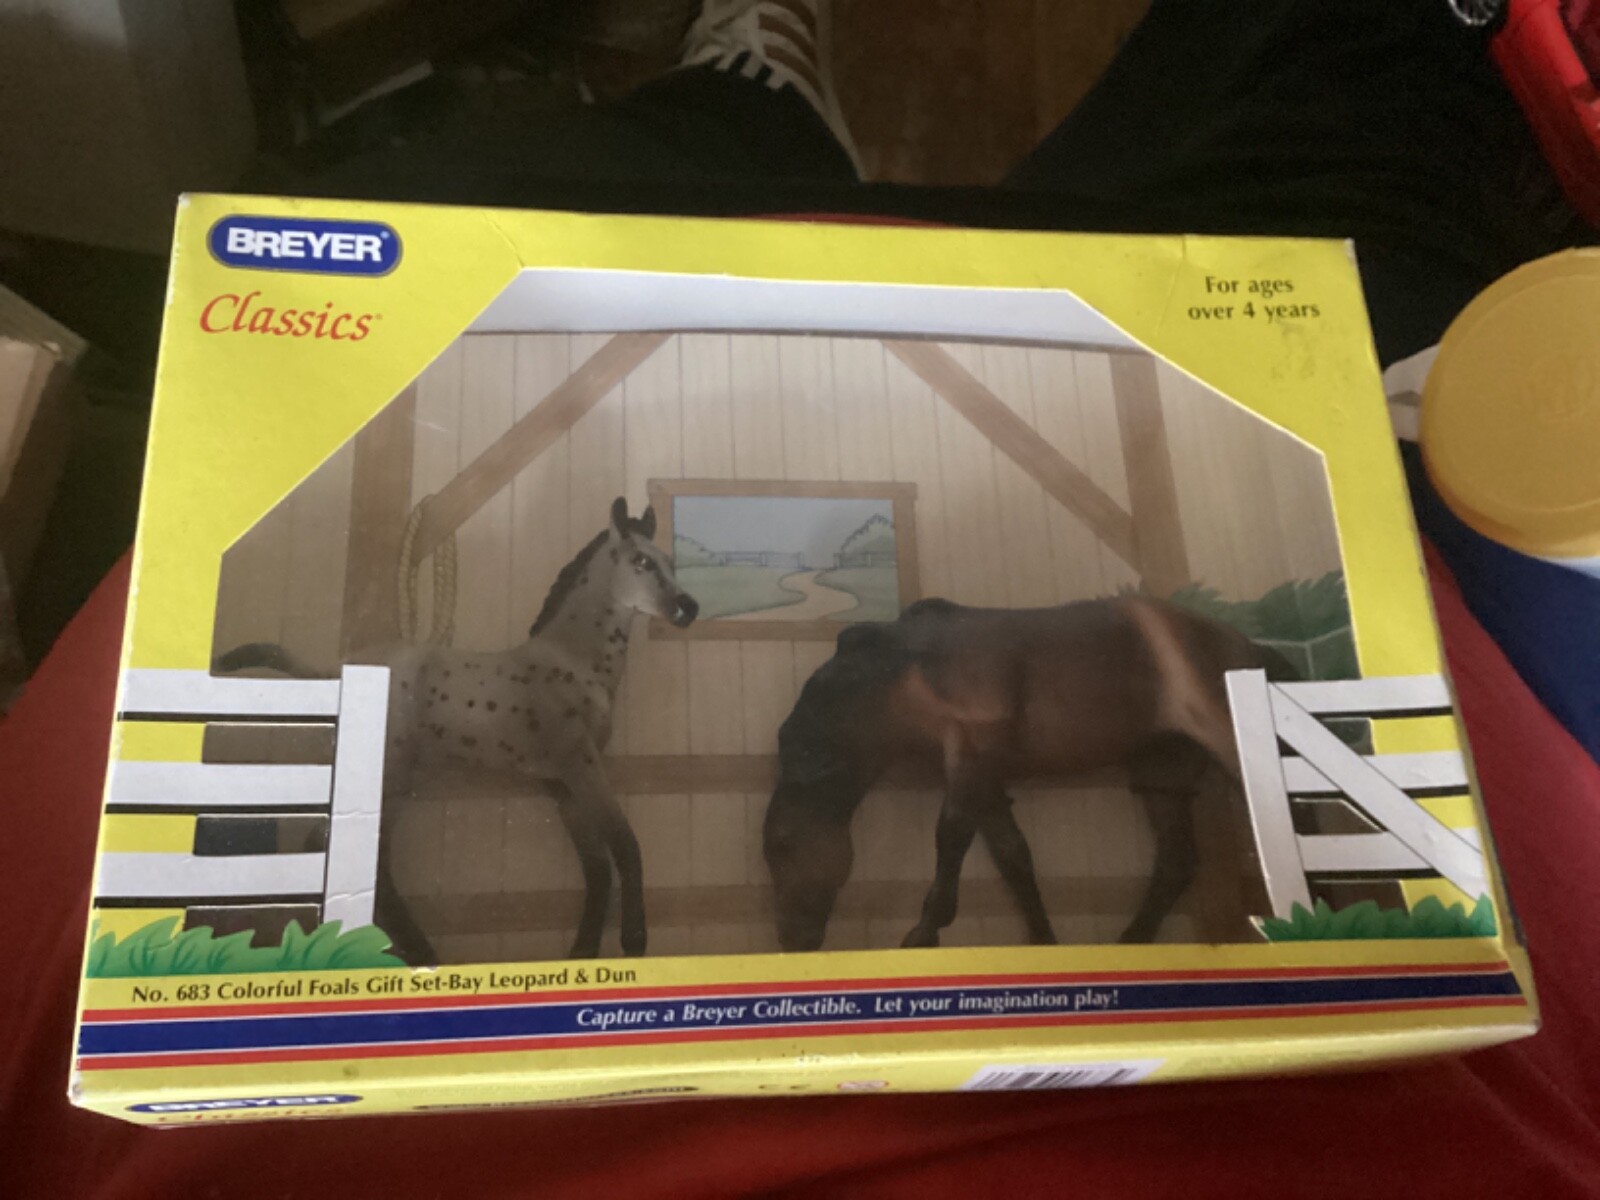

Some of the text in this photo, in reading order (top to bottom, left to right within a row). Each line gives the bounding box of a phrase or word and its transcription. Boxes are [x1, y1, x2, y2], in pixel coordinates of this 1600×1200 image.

[227, 227, 382, 261] BREYER
[1205, 276, 1294, 298] For ages
[199, 291, 373, 341] Classics
[1188, 301, 1321, 324] over 4 years
[132, 967, 636, 1002] No. 683 Colorful Foals Gift Set-Bay Leopard & Dun
[576, 988, 1119, 1030] Capture a Breyer Collectible. Let your imagination play!
